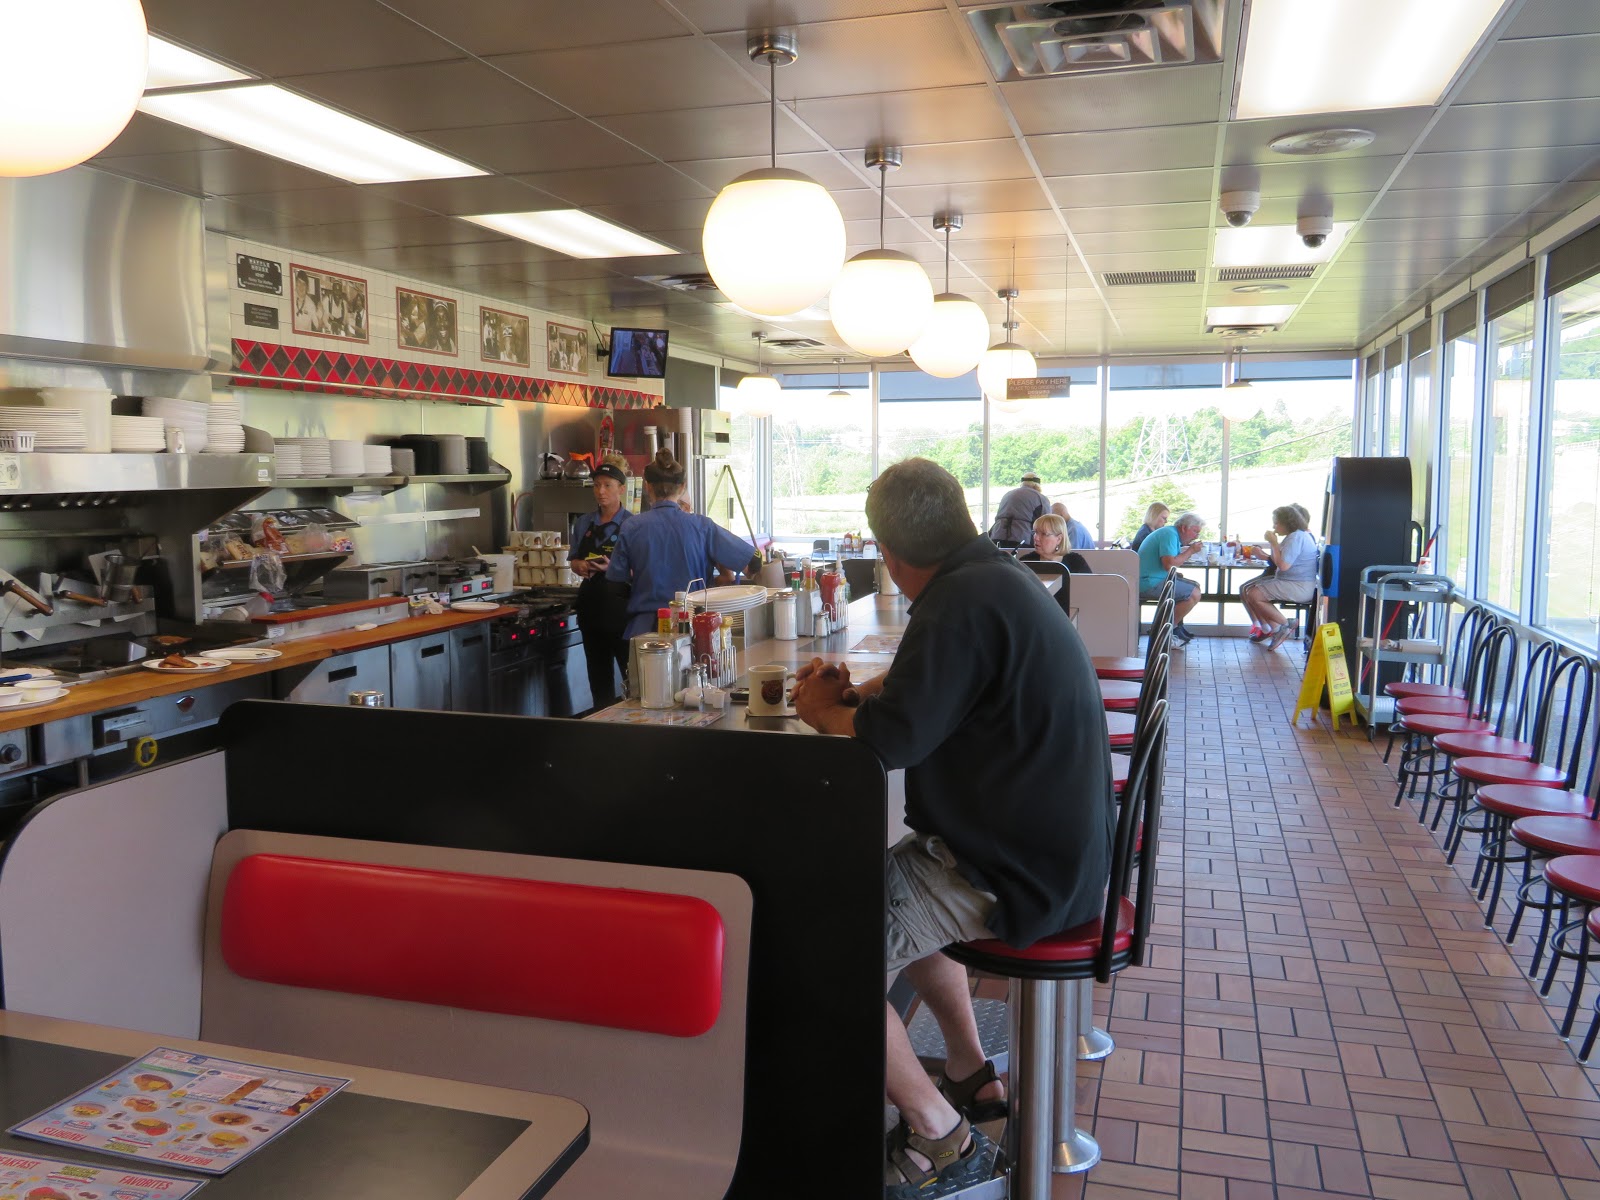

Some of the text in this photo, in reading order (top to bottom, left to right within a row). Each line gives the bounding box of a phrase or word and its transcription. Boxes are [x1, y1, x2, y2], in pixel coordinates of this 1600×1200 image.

[39, 1127, 88, 1142] FAVORITES
[0, 1154, 41, 1170] EAKFAST
[158, 1151, 214, 1166] BREAKFAST
[118, 1175, 174, 1190] FAVORITES
